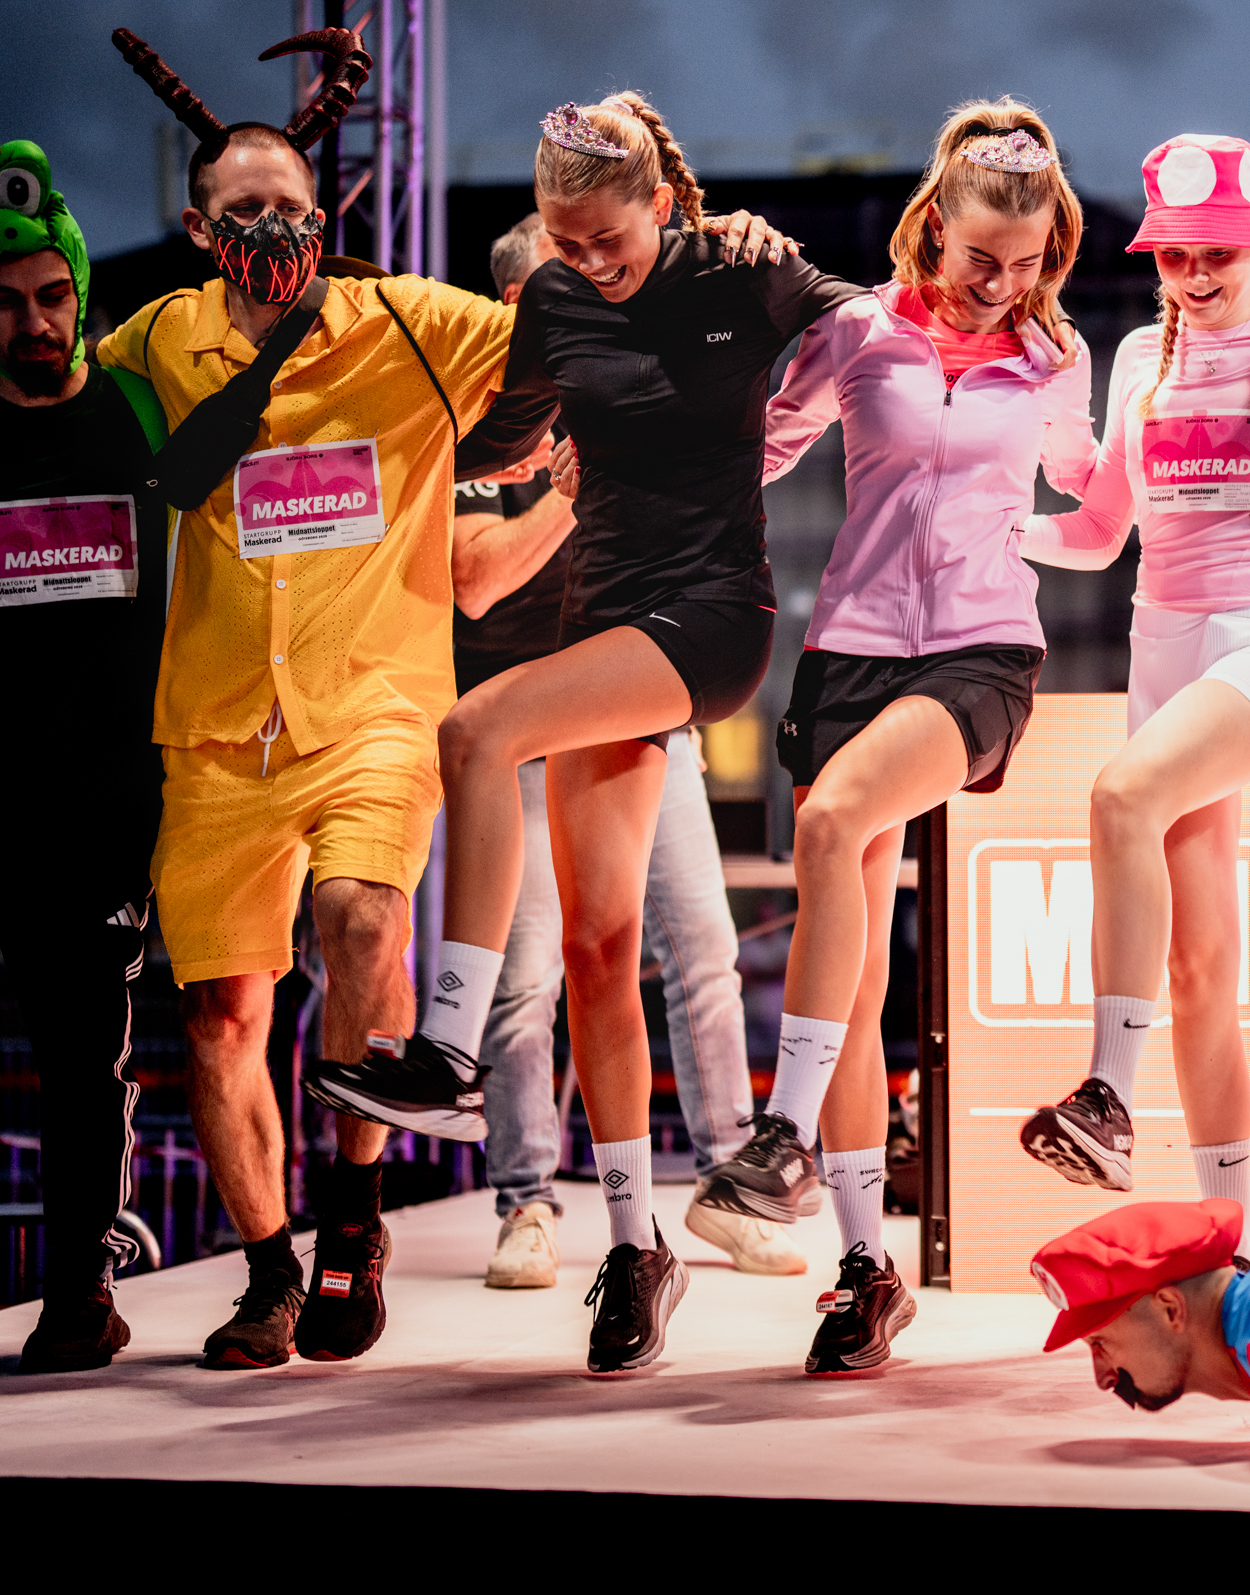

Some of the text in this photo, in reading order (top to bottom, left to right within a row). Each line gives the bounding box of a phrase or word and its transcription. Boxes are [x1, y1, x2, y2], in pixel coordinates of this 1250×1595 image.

[706, 331, 732, 343] ICIW
[1178, 487, 1220, 496] Midnattsloppet
[1148, 494, 1175, 503] Maskerad
[252, 491, 368, 522] MASKERAD
[243, 529, 282, 540] STARTGRUPP
[287, 525, 336, 537] Midnattsloppet
[244, 535, 283, 547] Maskerad
[5, 545, 123, 570] MASKERAD
[43, 575, 92, 587] Midnattsloppet
